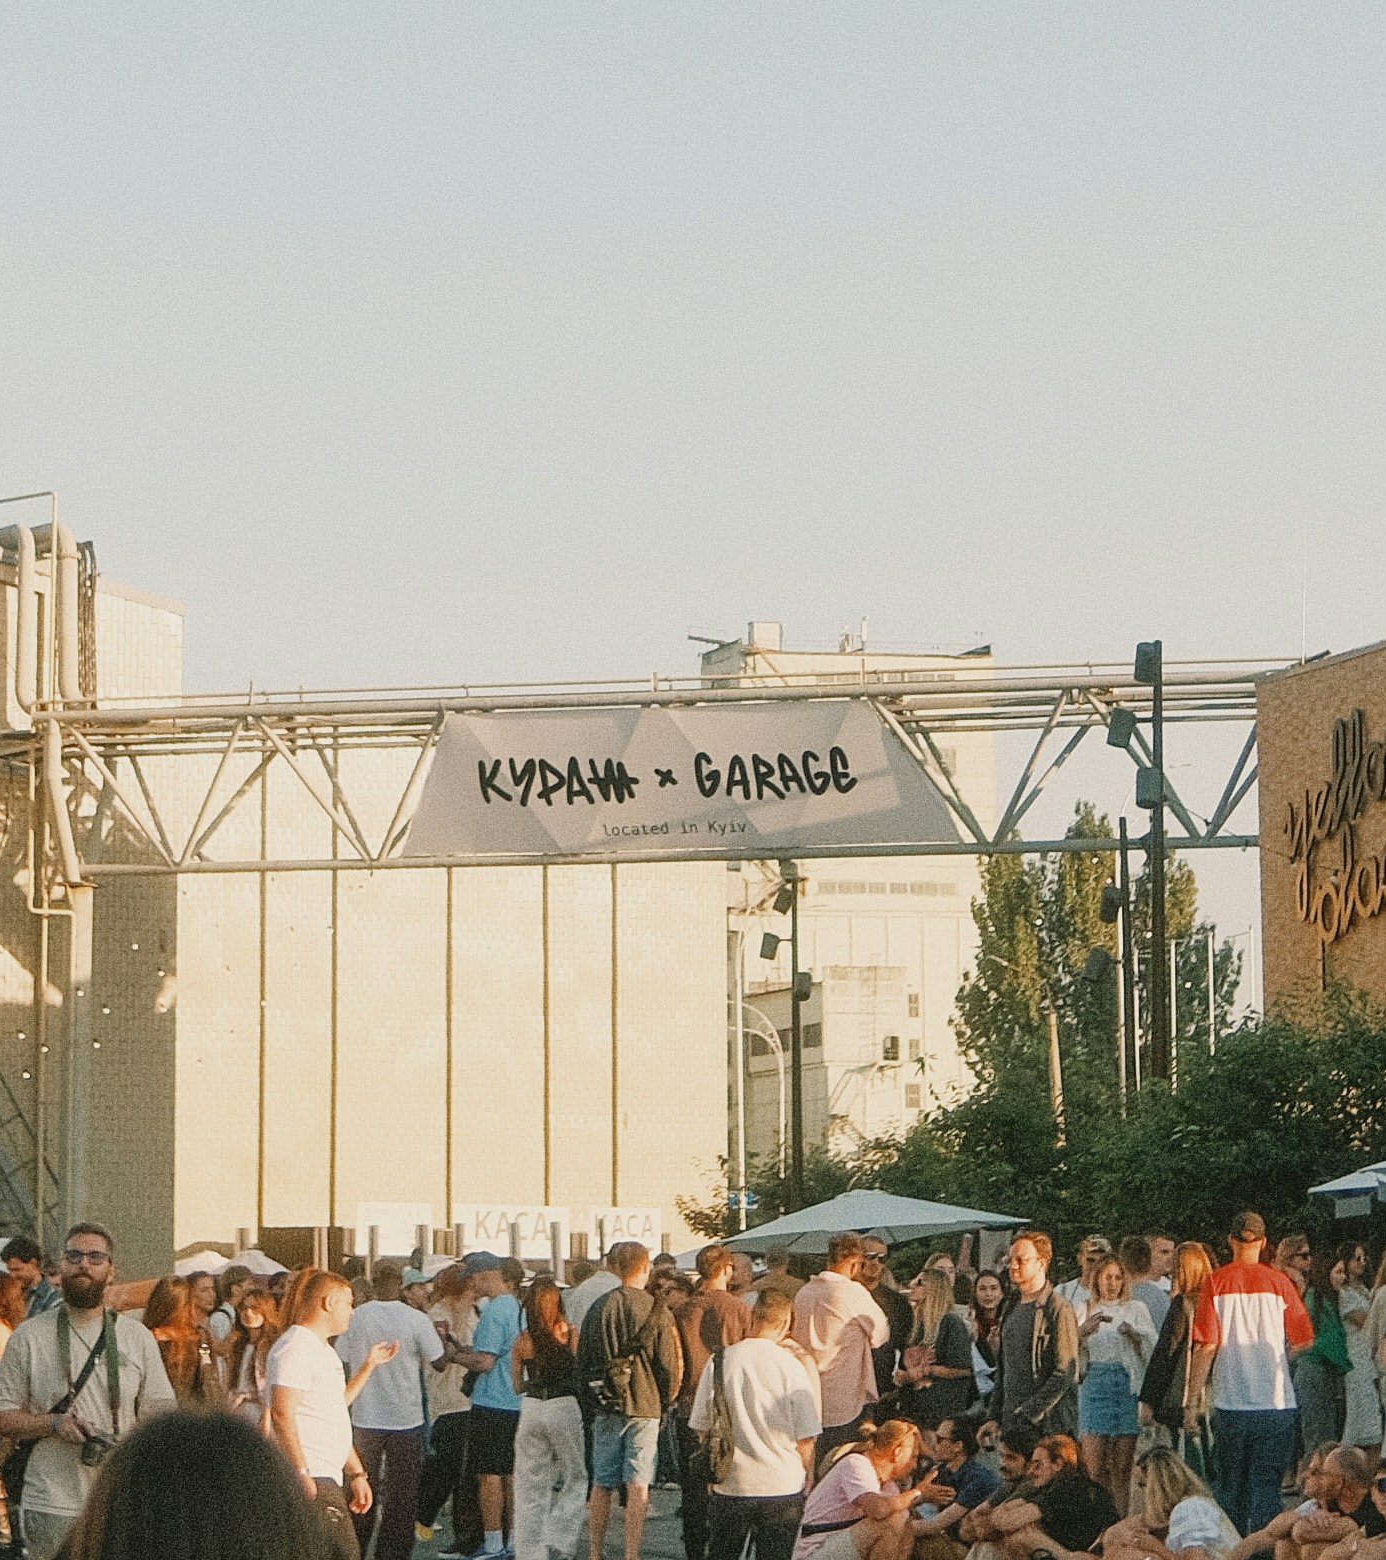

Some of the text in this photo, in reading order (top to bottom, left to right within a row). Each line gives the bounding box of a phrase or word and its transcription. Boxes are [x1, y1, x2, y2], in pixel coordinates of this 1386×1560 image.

[477, 756, 640, 807] КУРАЖ
[693, 746, 858, 801] GARAGE
[603, 820, 747, 837] located in Kyiv
